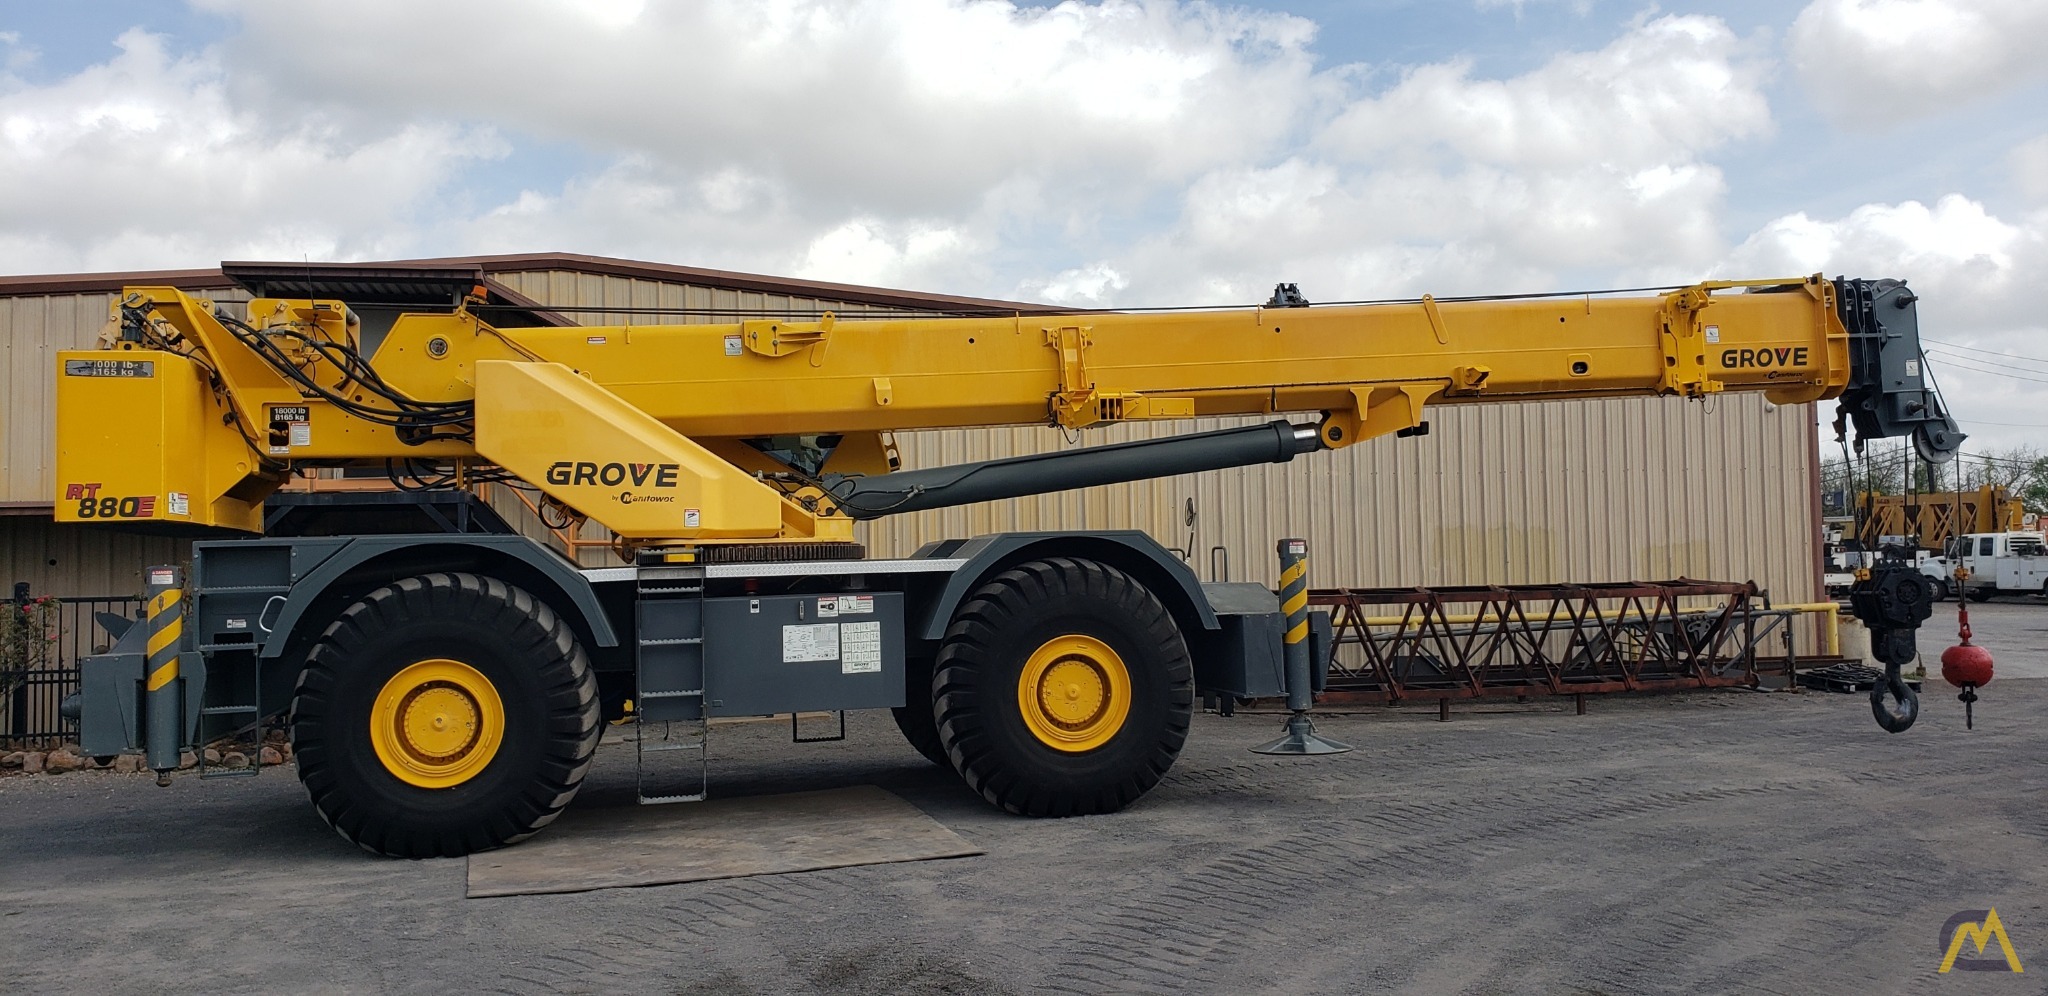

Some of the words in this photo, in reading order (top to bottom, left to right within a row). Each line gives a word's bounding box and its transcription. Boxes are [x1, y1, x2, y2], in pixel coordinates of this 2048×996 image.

[1721, 347, 1808, 369] GROVE
[121, 368, 134, 377] kg
[295, 414, 305, 422] kg
[546, 461, 680, 488] GROVE
[65, 483, 102, 500] RT
[611, 494, 619, 502] by
[620, 491, 675, 505] Manitowoc
